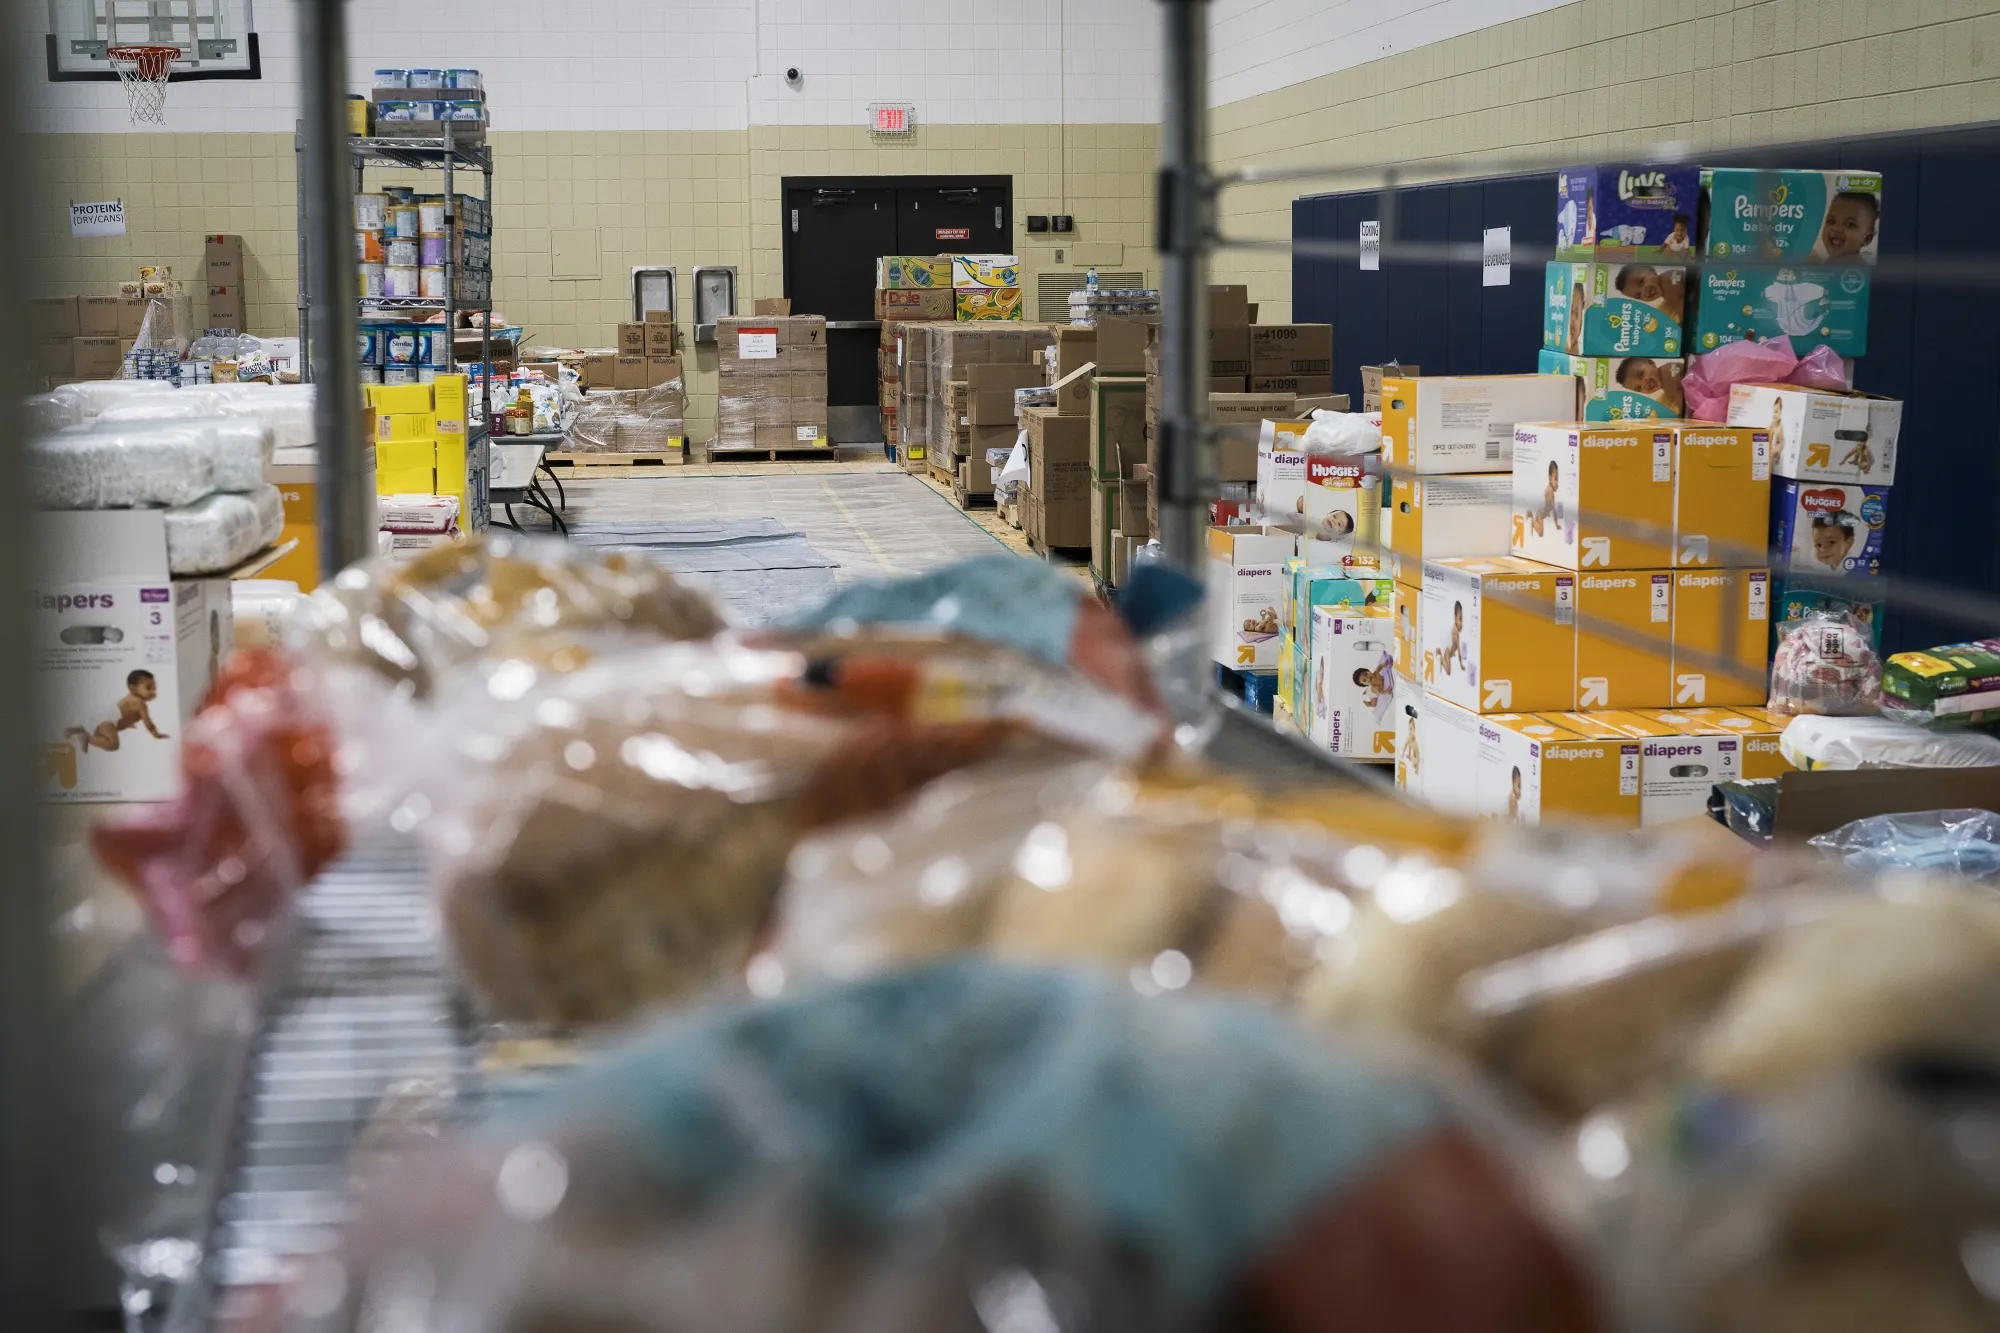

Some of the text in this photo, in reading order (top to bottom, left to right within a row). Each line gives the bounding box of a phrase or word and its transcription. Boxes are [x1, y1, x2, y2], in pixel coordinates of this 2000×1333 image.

[878, 109, 903, 128] EXIT
[73, 203, 123, 215] PROTEINS
[1735, 194, 1804, 221] Pampers
[73, 213, 124, 226] (DRY/CANS)
[1743, 222, 1794, 234] baby-dry
[1484, 253, 1510, 267] BEVERAGES
[1708, 274, 1746, 289] Pampers
[889, 291, 921, 304] Dole
[1614, 303, 1632, 352] Pampers
[392, 340, 413, 348] Similac
[1515, 428, 1537, 444] diapers
[1583, 434, 1638, 450] diapers
[1684, 432, 1738, 448] diapers
[1658, 448, 1665, 457] 3
[1757, 447, 1764, 456] 3
[1274, 454, 1304, 466] diape
[1312, 464, 1359, 477] HUGGIES
[1805, 496, 1841, 507] HUGGIES
[1357, 556, 1374, 565] 132
[1237, 568, 1272, 578] diapers
[1485, 578, 1540, 593] diapers
[1581, 576, 1637, 591] diapers
[1679, 574, 1734, 588] diapers
[1560, 592, 1568, 600] 3
[1656, 589, 1664, 597] 3
[1754, 587, 1761, 596] 3
[35, 590, 115, 614] iapers
[150, 611, 162, 625] 3
[1330, 710, 1341, 752] diapers
[1479, 723, 1501, 744] diapers
[1545, 746, 1604, 761] diapers
[1643, 743, 1702, 759] diapers
[1746, 739, 1779, 755] diap
[1626, 760, 1633, 770] 3
[1723, 756, 1731, 766] 3
